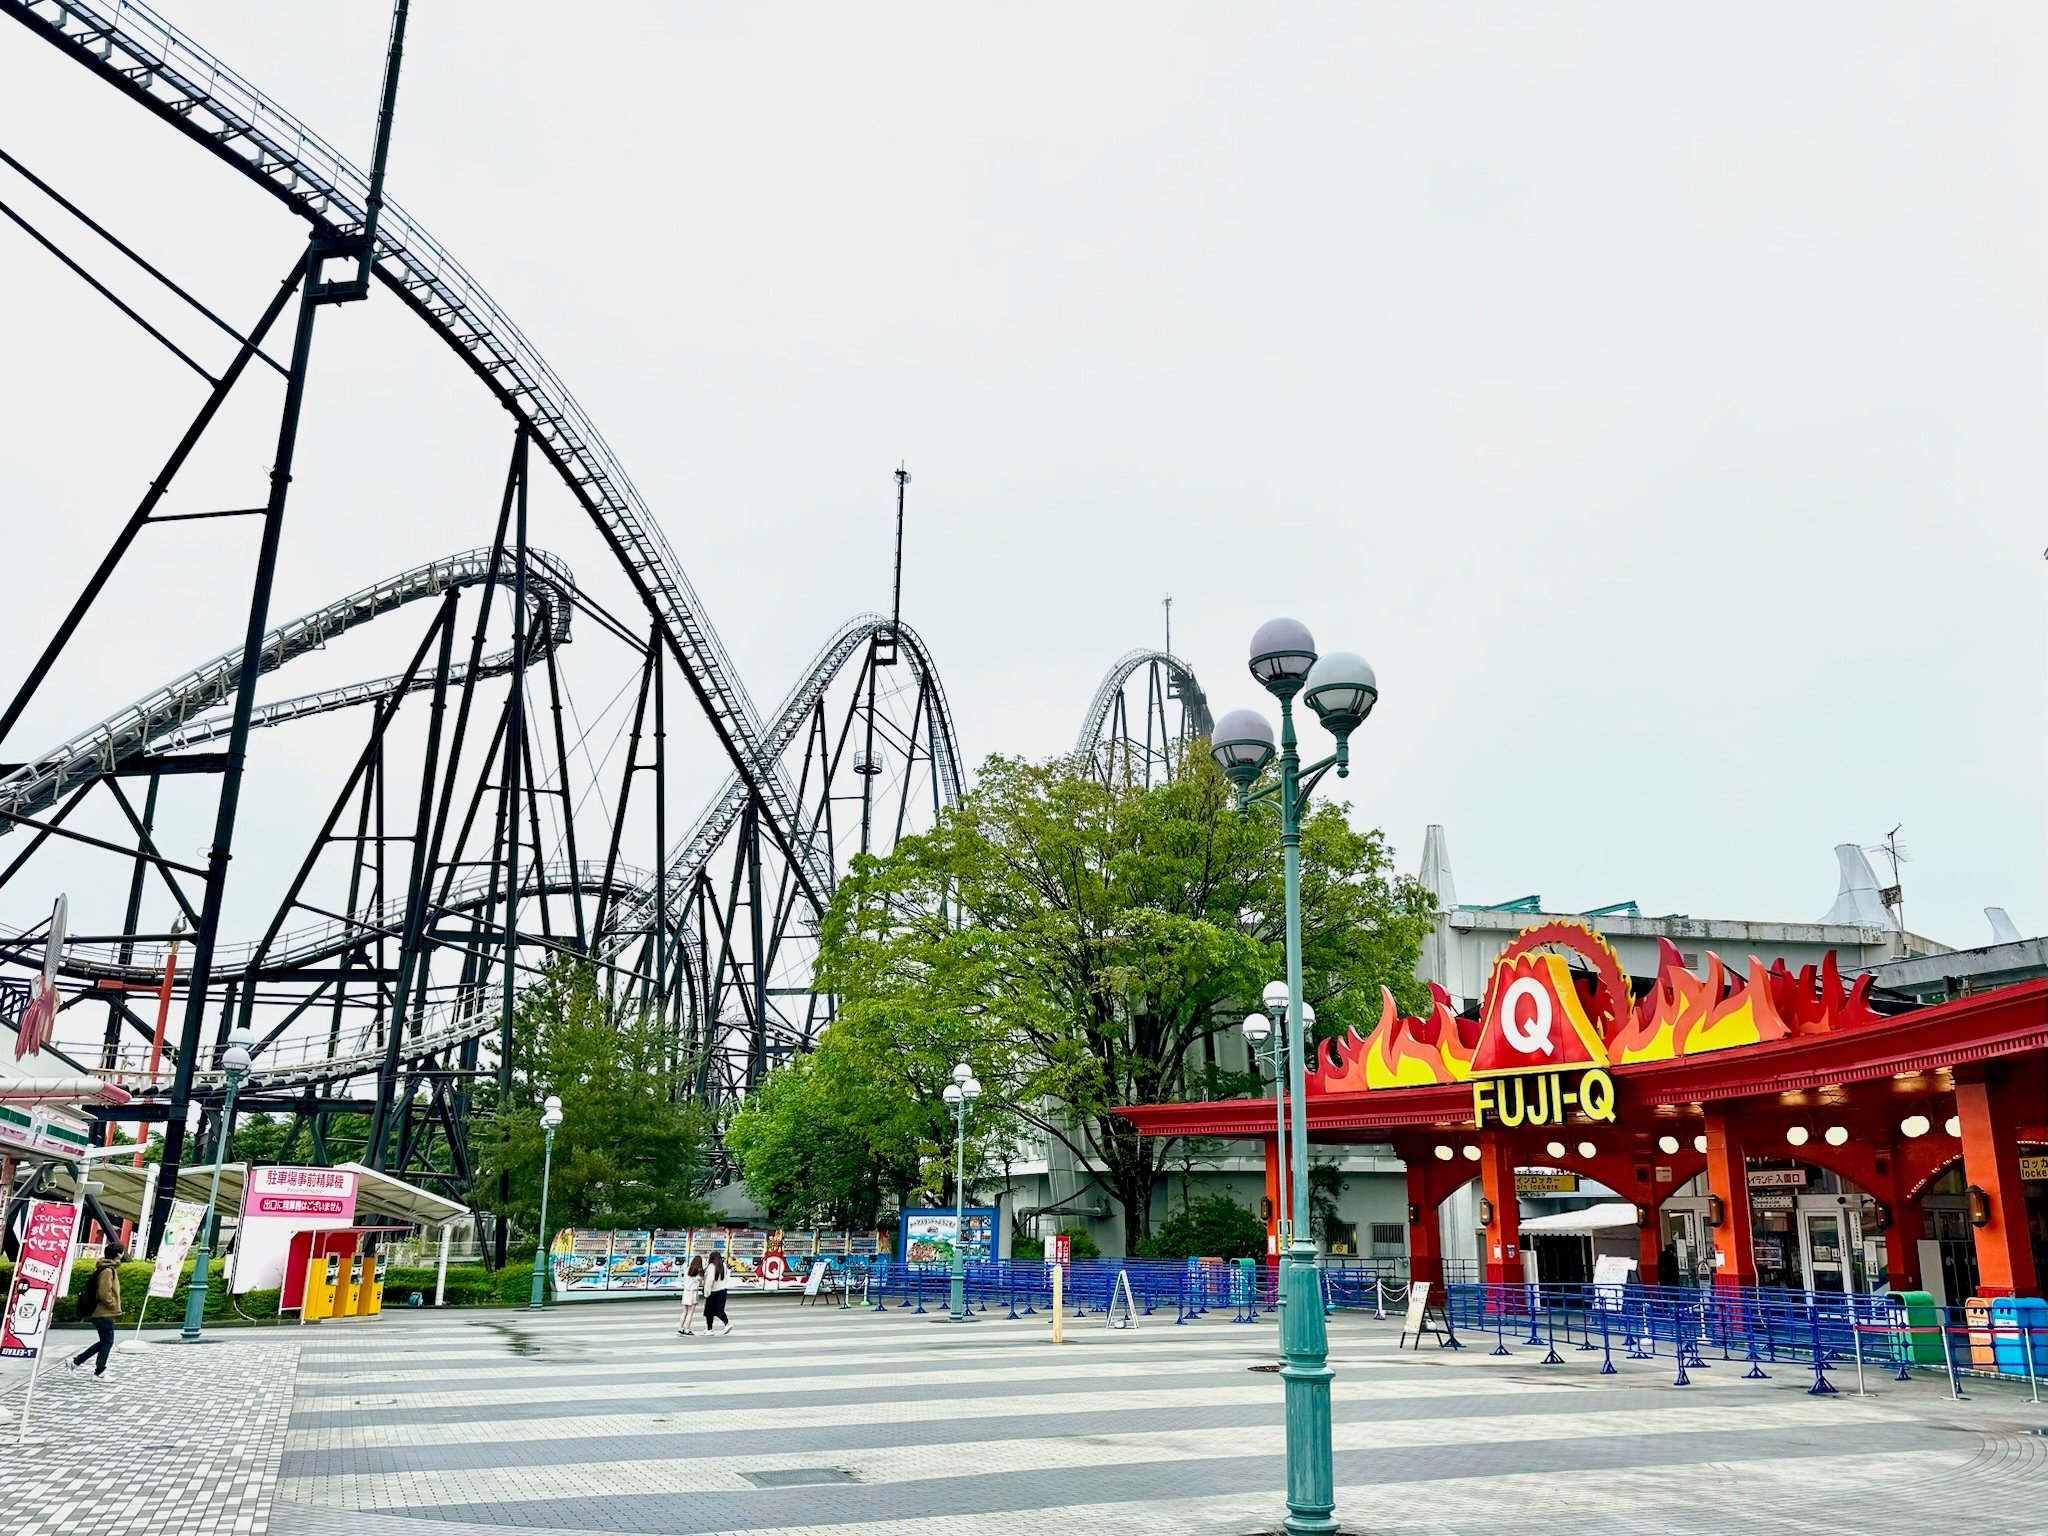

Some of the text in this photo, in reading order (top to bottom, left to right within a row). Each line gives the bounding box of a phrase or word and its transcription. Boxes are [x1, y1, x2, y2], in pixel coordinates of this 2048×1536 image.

[1501, 976, 1555, 1057] Q
[1473, 1069, 1617, 1128] FUJI-Q
[2021, 1158, 2048, 1169] ロッカ
[267, 1170, 345, 1189] 駐車場事前精算機
[1748, 1175, 1773, 1184] イランド
[2021, 1169, 2048, 1178] locke
[762, 1256, 784, 1280] Q
